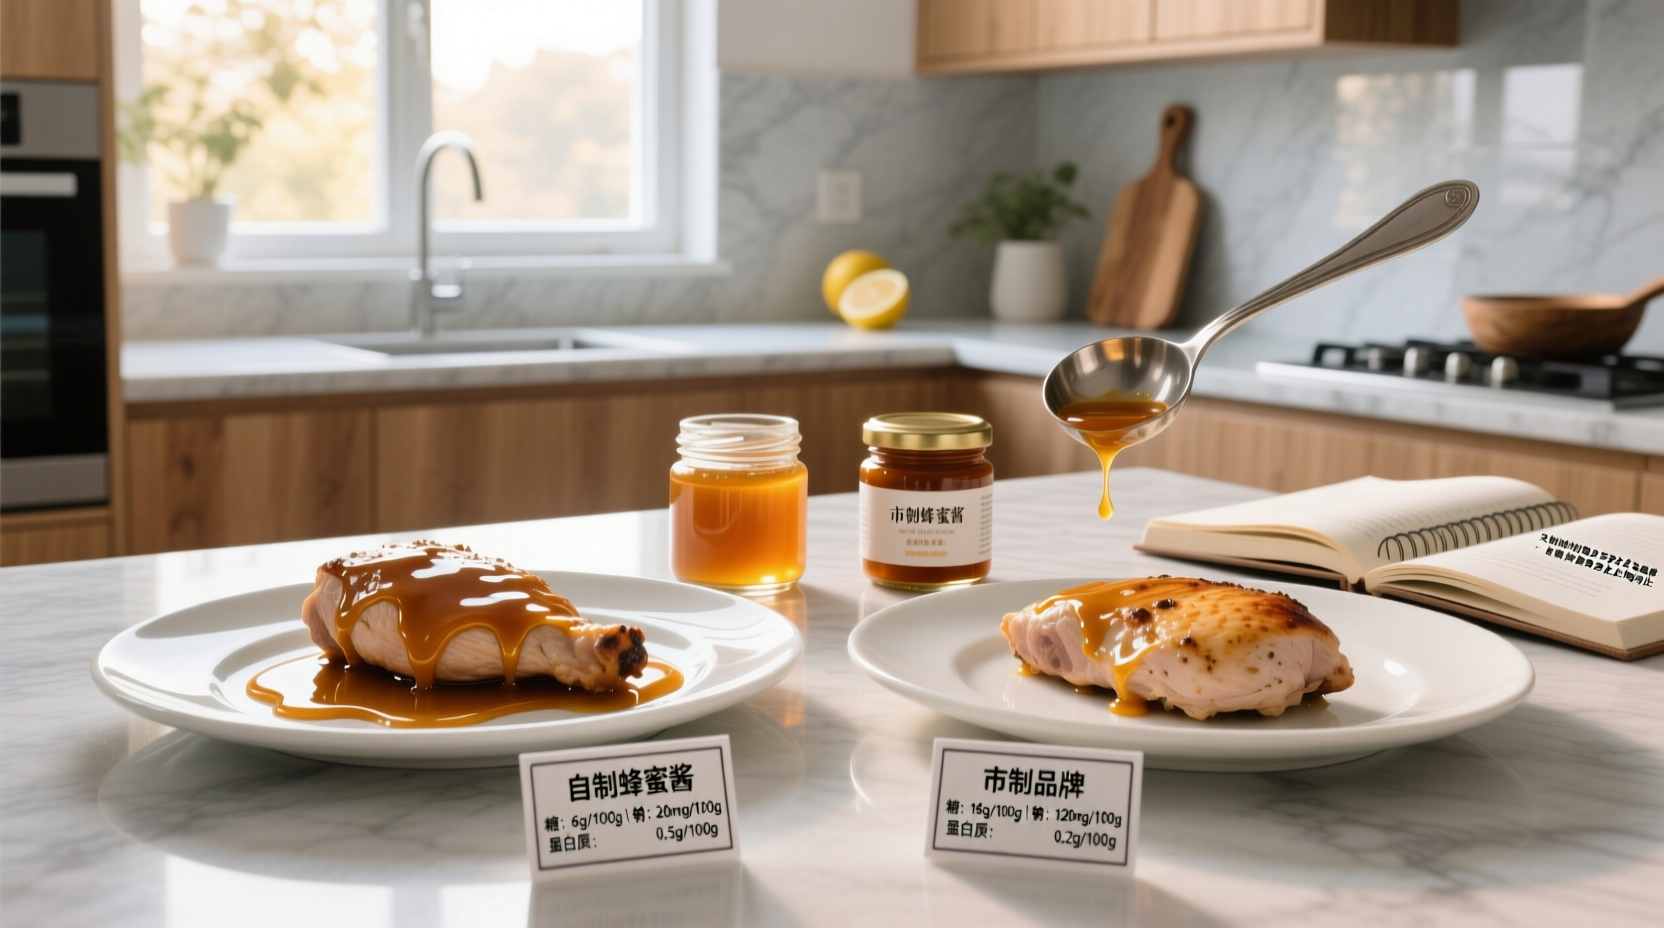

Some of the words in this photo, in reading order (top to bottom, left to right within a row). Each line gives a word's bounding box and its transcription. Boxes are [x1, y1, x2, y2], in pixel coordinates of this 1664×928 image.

[568, 762, 694, 802] 自制蜂蜜酱
[984, 766, 1085, 799] 市制品牌
[656, 822, 719, 841] 0.5g/100g
[1054, 829, 1117, 850] 0.2g/100g
